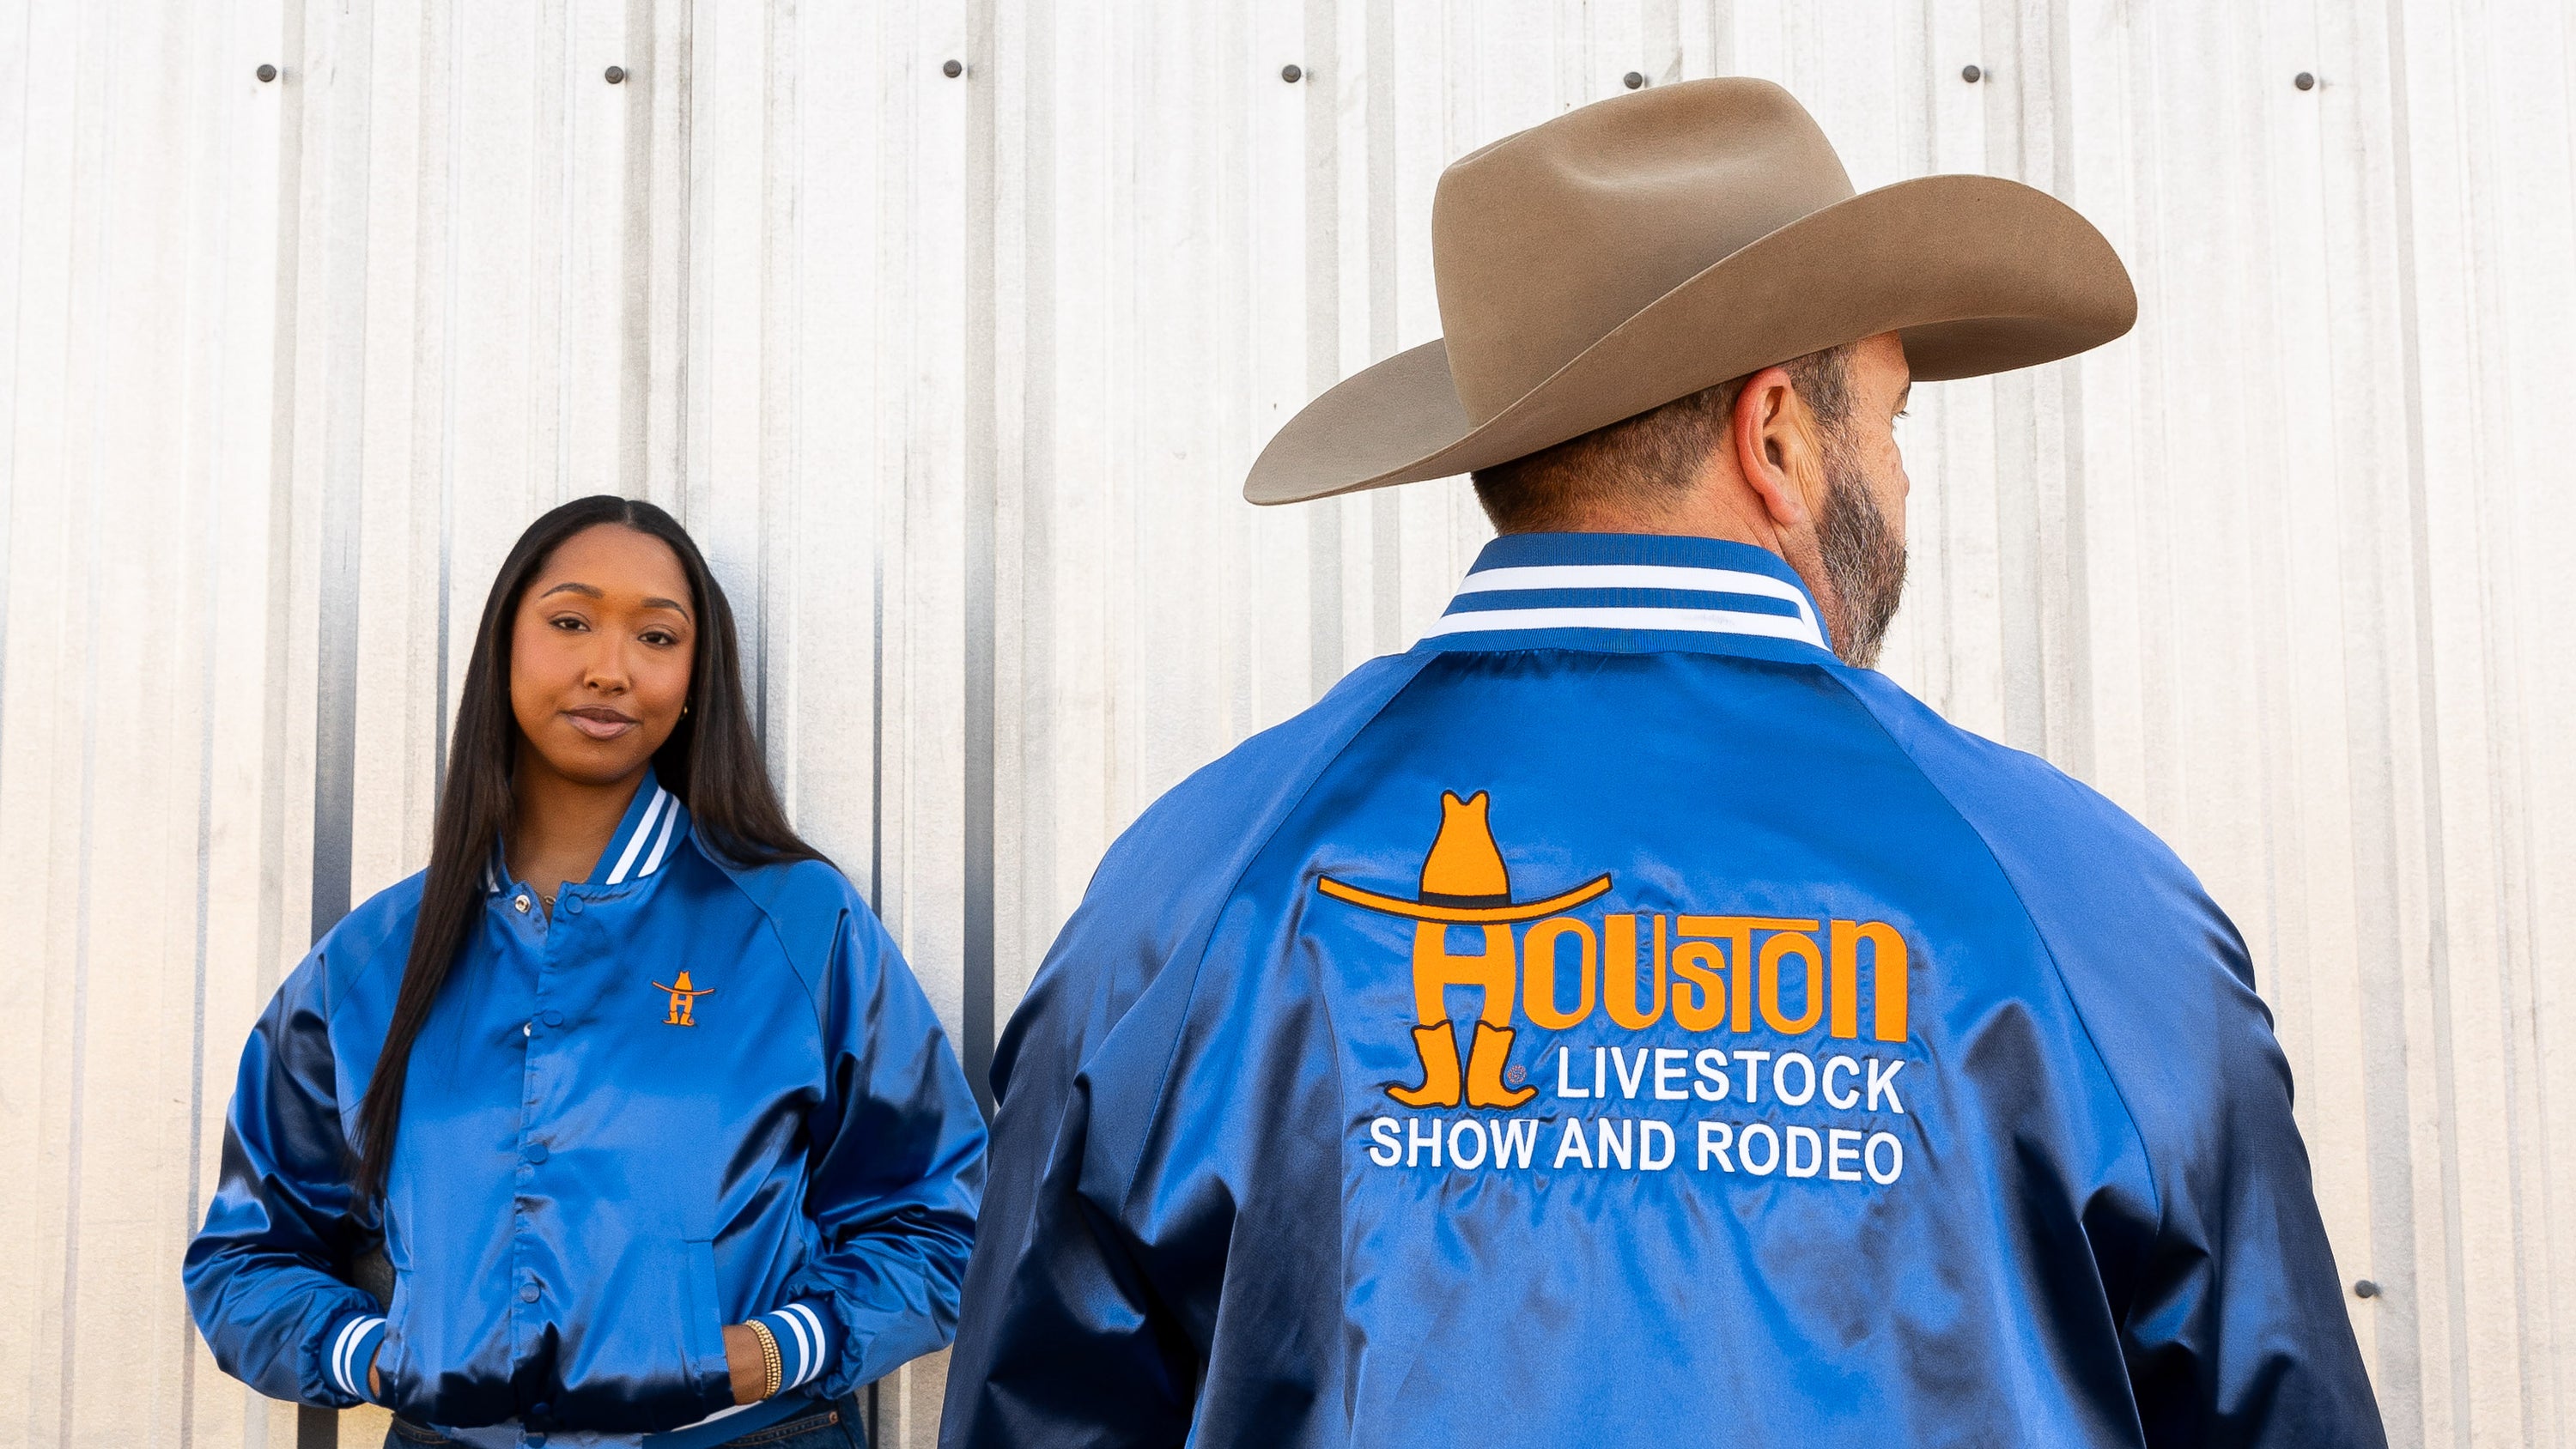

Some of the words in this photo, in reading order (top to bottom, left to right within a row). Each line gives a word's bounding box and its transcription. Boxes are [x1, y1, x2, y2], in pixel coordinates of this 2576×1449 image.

[1557, 1046, 1905, 1114] LIVESTOCK
[1369, 1116, 1540, 1170] SHOW
[1553, 1117, 1676, 1171] AND
[1698, 1120, 1904, 1185] RODEO
